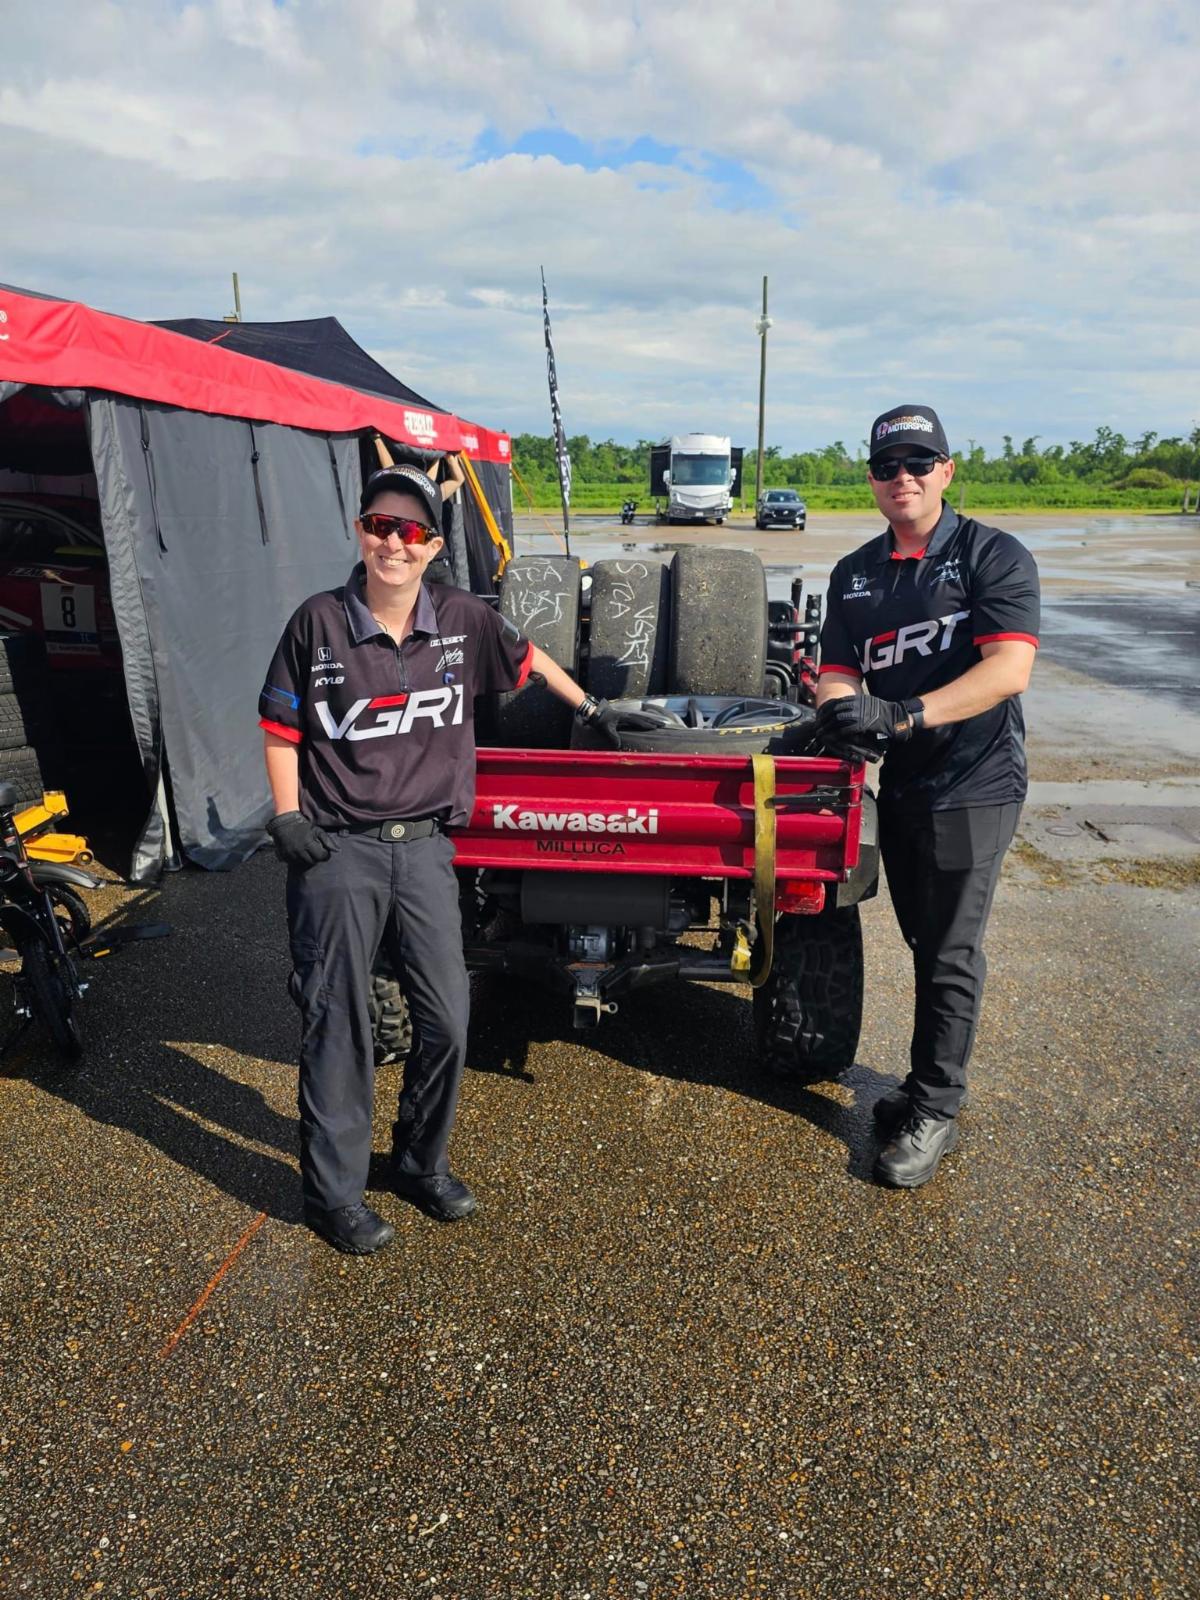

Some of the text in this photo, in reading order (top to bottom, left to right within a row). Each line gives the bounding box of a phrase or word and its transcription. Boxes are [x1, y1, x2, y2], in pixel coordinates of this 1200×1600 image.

[508, 565, 562, 586] TCA
[609, 581, 636, 619] TCA
[842, 590, 872, 600] HONDA
[61, 596, 76, 628] 8
[311, 662, 345, 672] HONDA
[493, 804, 659, 834] Kawasaki
[536, 839, 626, 855] MILLUCA
